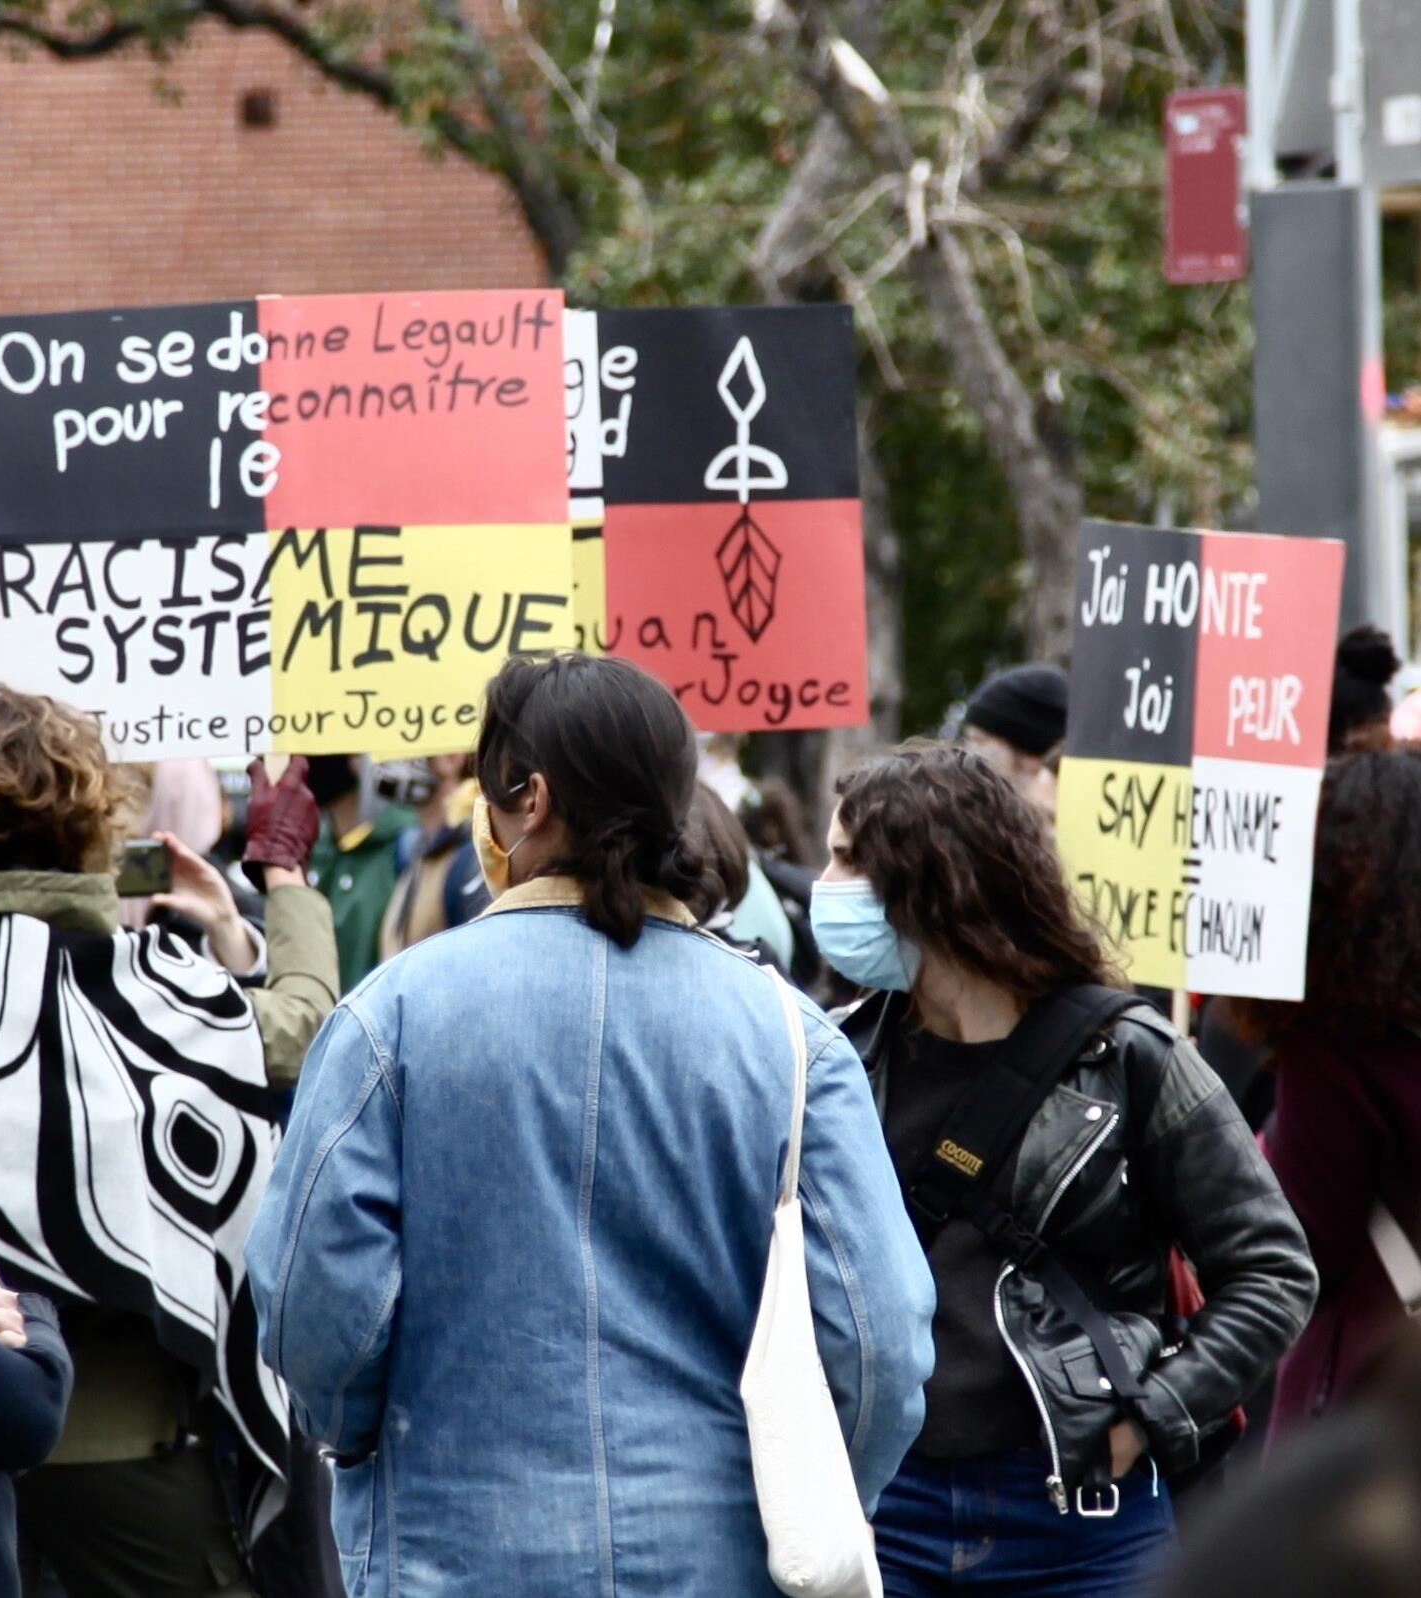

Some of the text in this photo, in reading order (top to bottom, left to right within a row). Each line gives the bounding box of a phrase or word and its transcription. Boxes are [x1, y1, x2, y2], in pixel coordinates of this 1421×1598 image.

[116, 331, 195, 378] se
[206, 311, 350, 372] donne
[372, 299, 555, 368] Legault
[53, 366, 531, 473] pour reconnaître
[209, 437, 281, 509] le
[1143, 560, 1268, 640] HONTE
[245, 710, 335, 753] pour
[344, 690, 478, 743] Joyce
[701, 653, 851, 726] Joyce
[1226, 674, 1303, 748] PEUR
[1098, 773, 1283, 864] SAY HER NAME
